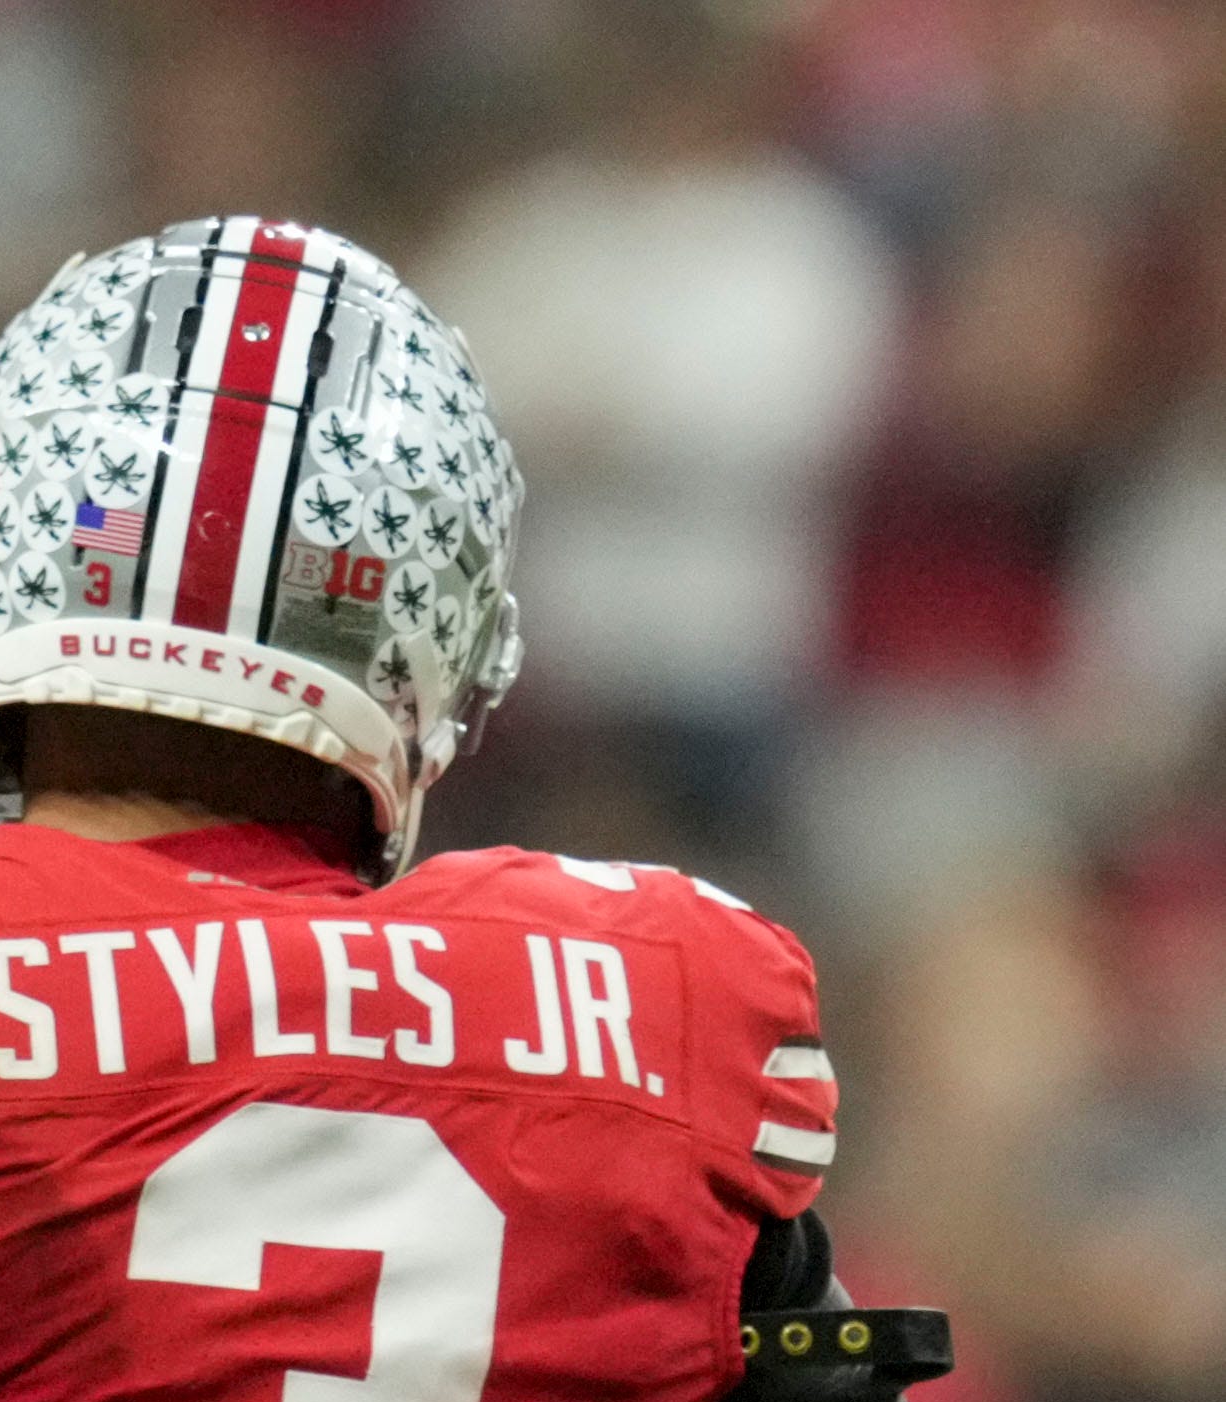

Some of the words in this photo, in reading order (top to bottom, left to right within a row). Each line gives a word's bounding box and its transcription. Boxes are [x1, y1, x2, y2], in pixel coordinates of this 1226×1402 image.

[84, 562, 112, 607] 3
[60, 633, 326, 707] BUCKEYES
[504, 932, 665, 1097] JR.
